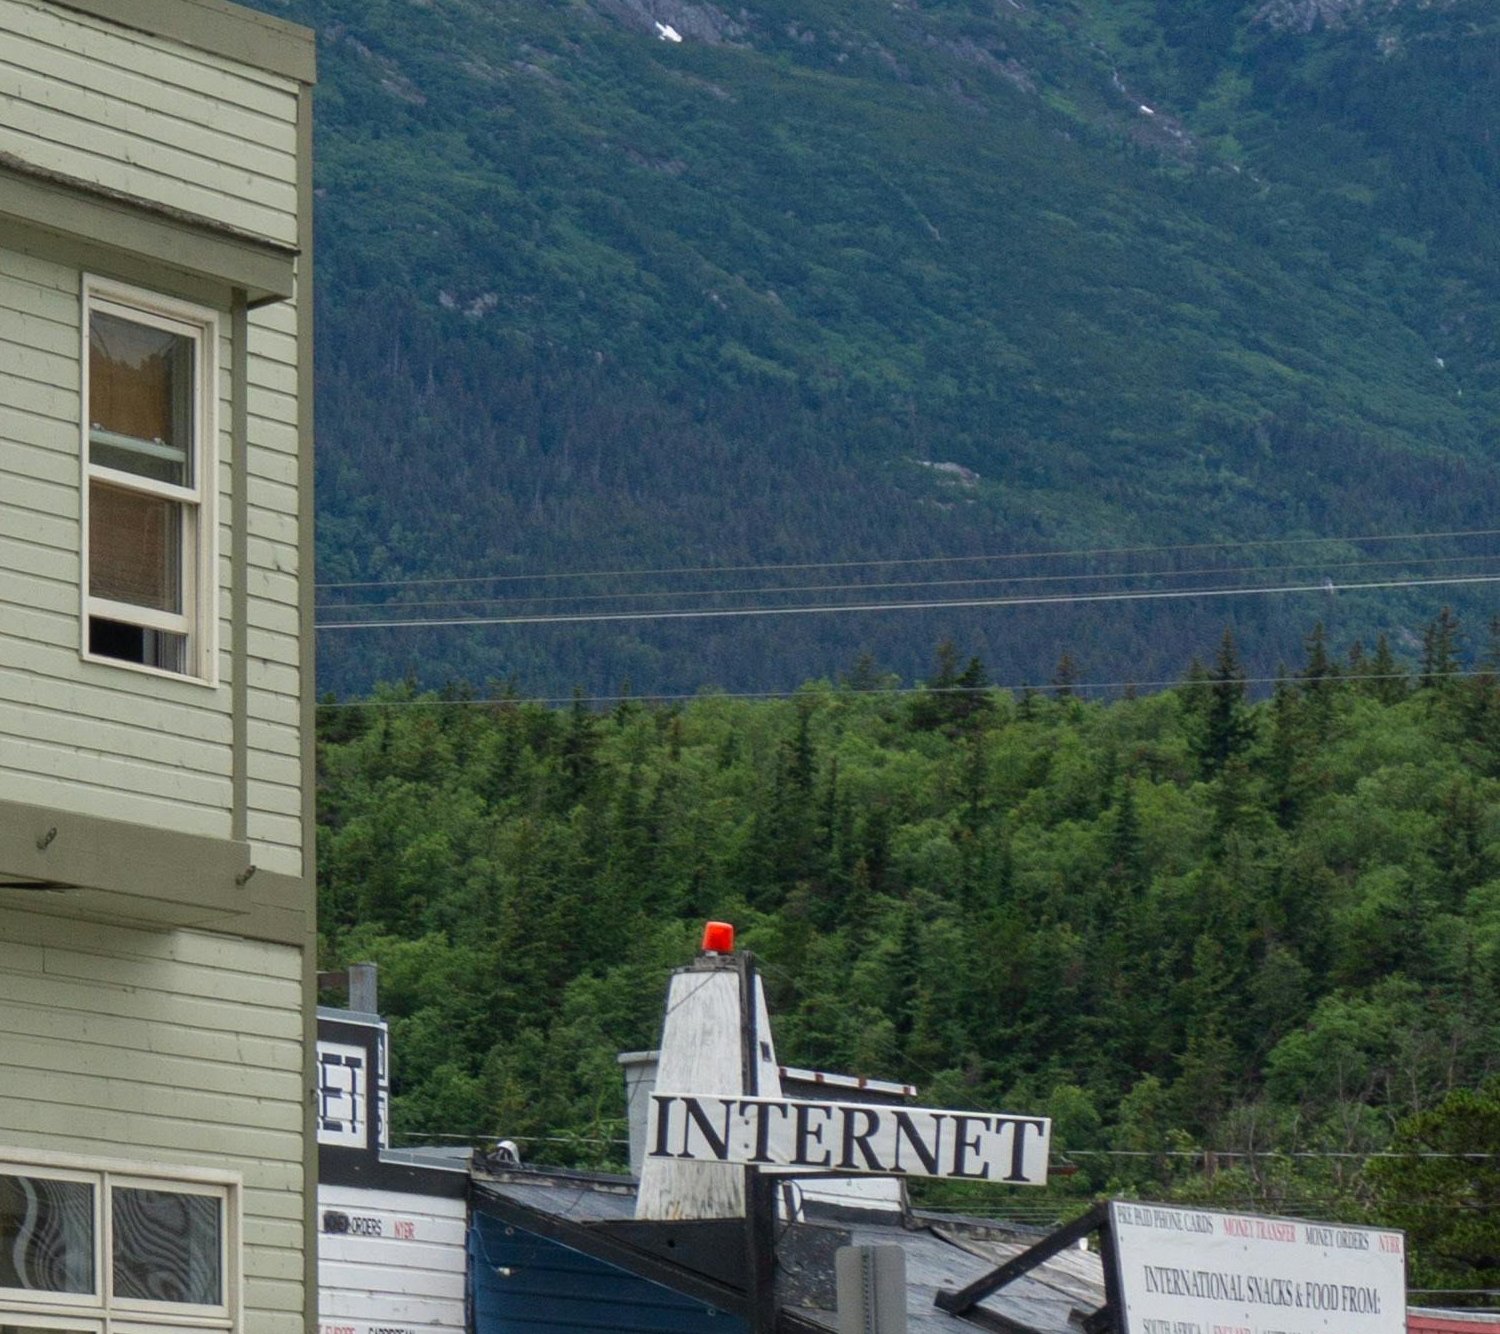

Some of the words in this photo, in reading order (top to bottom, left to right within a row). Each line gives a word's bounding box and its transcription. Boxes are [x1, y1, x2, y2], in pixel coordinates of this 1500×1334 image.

[648, 1095, 1045, 1182] INTERNET
[1153, 1209, 1183, 1231] PHONE
[1184, 1214, 1214, 1234] CARDS
[1222, 1218, 1252, 1238] MONEY
[1256, 1221, 1296, 1243] TRANSFER
[1305, 1229, 1334, 1247] MONEY
[1336, 1232, 1369, 1250] ORDERS
[1144, 1266, 1245, 1302] INTERNATIONAL
[1247, 1276, 1293, 1307] SNACKS
[1305, 1281, 1338, 1311] FOOD
[1341, 1285, 1381, 1315] FROM:
